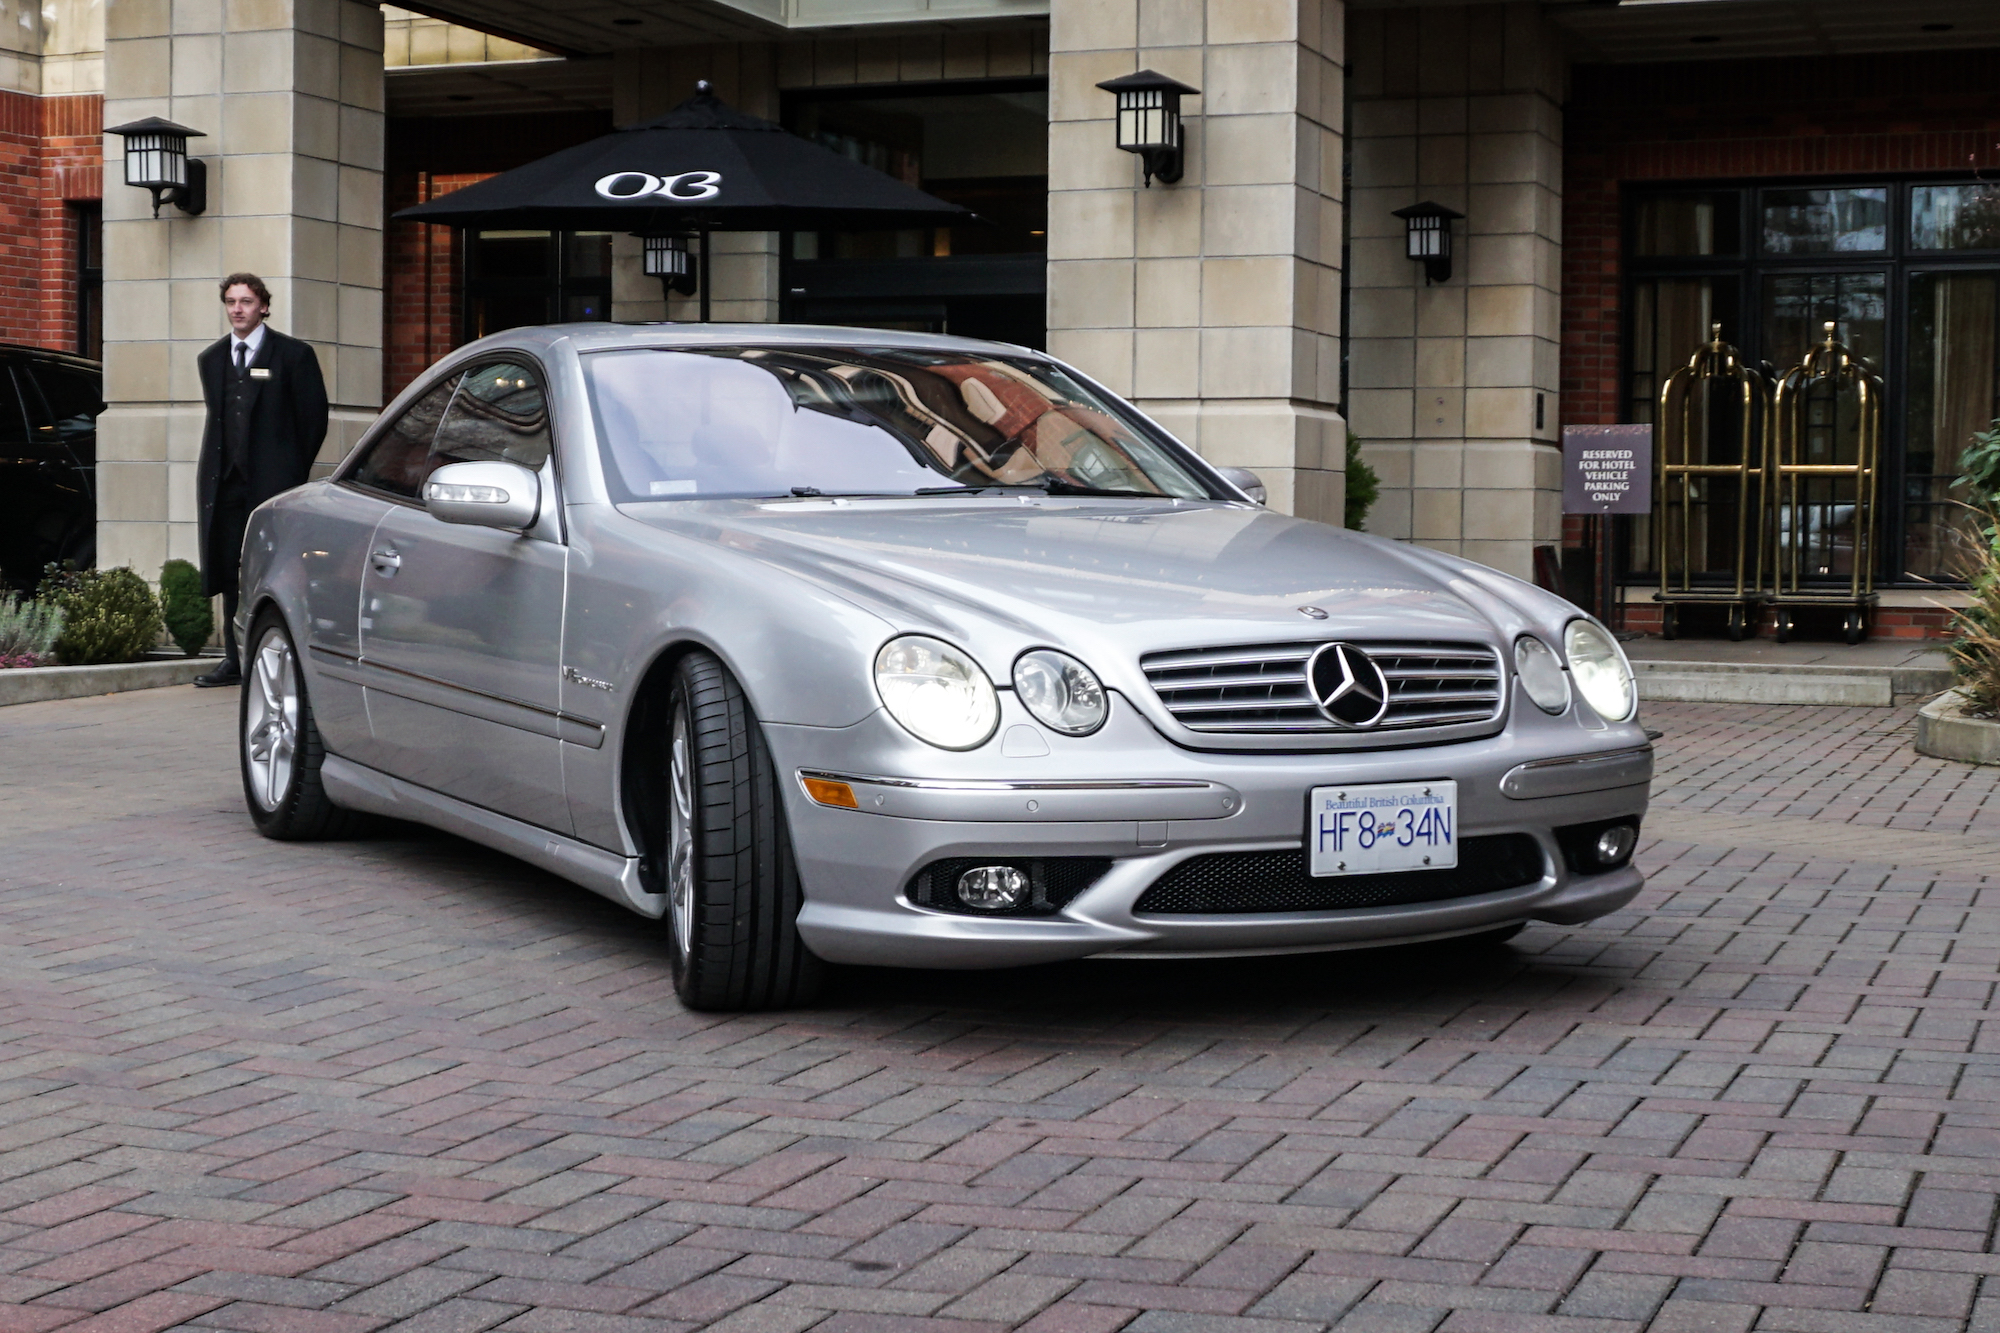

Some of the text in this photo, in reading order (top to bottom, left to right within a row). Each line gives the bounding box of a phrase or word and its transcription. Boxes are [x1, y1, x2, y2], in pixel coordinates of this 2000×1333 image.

[1583, 450, 1633, 459] RESERVED
[1579, 461, 1636, 470] FOR HOTEL
[1585, 471, 1628, 480] VEHICLE
[1584, 482, 1630, 491] PARKING
[1592, 492, 1621, 501] ONLY
[1326, 793, 1444, 810] Beautiful British Columbia
[1320, 806, 1452, 852] HF8 34N
